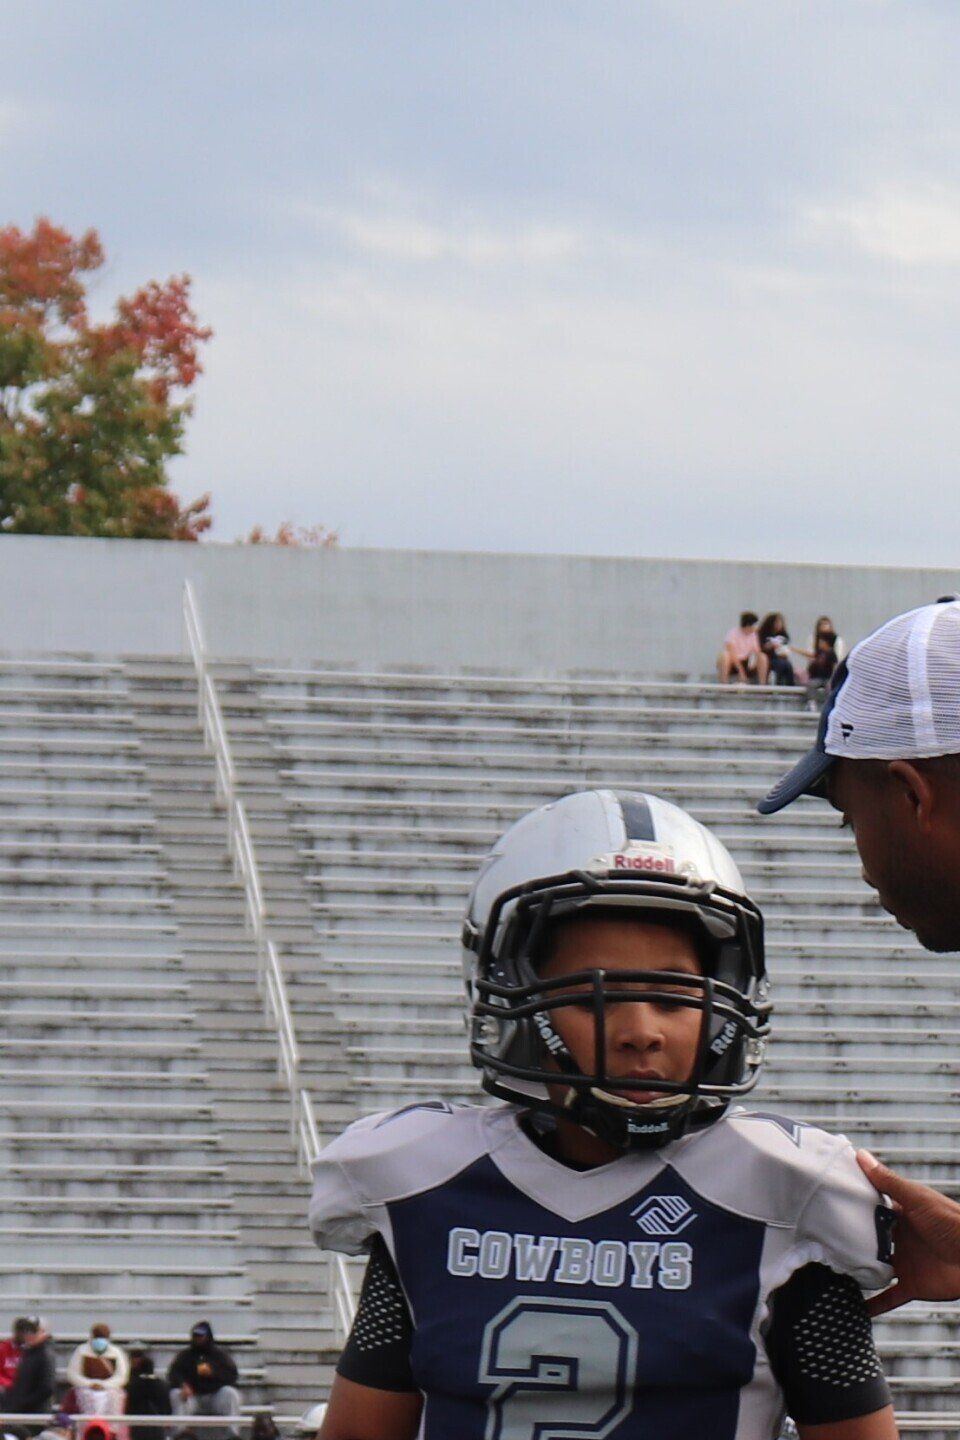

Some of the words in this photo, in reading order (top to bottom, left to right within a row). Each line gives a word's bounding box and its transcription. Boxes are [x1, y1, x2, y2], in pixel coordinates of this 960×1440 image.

[614, 854, 675, 873] Riddell
[628, 1122, 669, 1133] Riddell
[447, 1227, 692, 1290] COWBOYS
